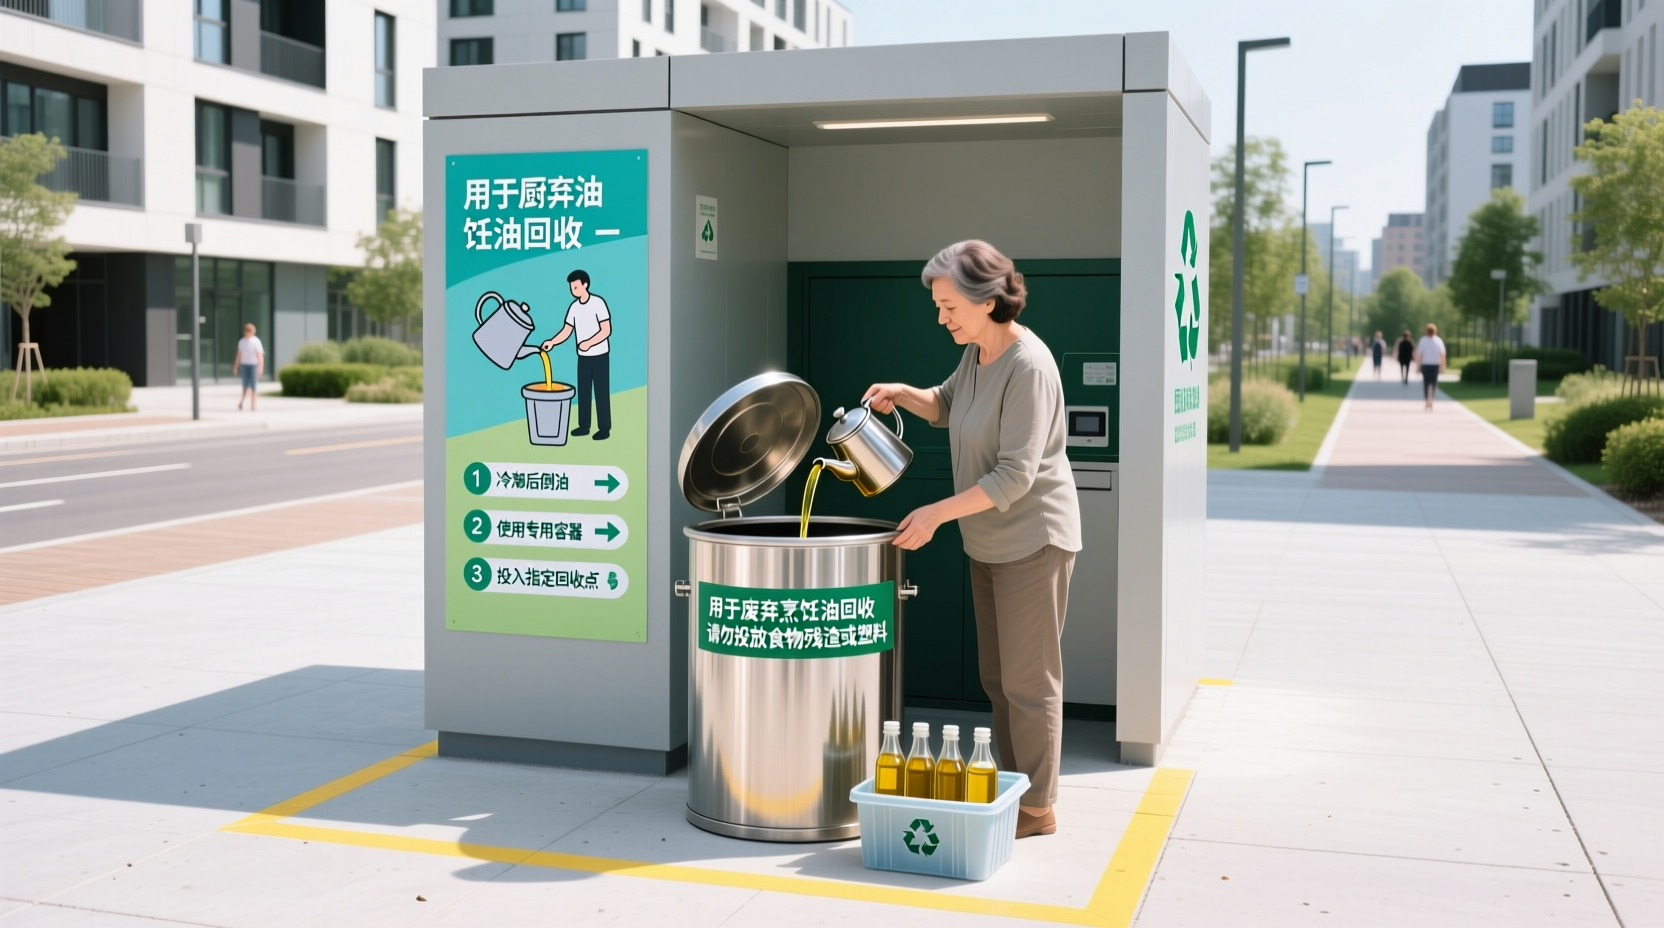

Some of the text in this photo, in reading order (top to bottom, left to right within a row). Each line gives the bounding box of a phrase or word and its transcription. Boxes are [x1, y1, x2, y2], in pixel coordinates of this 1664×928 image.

[472, 469, 480, 488] 1
[471, 517, 583, 541] 2 使用专用容器
[471, 564, 600, 590] 3 投入指定回收点
[709, 595, 875, 623] 用于废弃烹饪油回收
